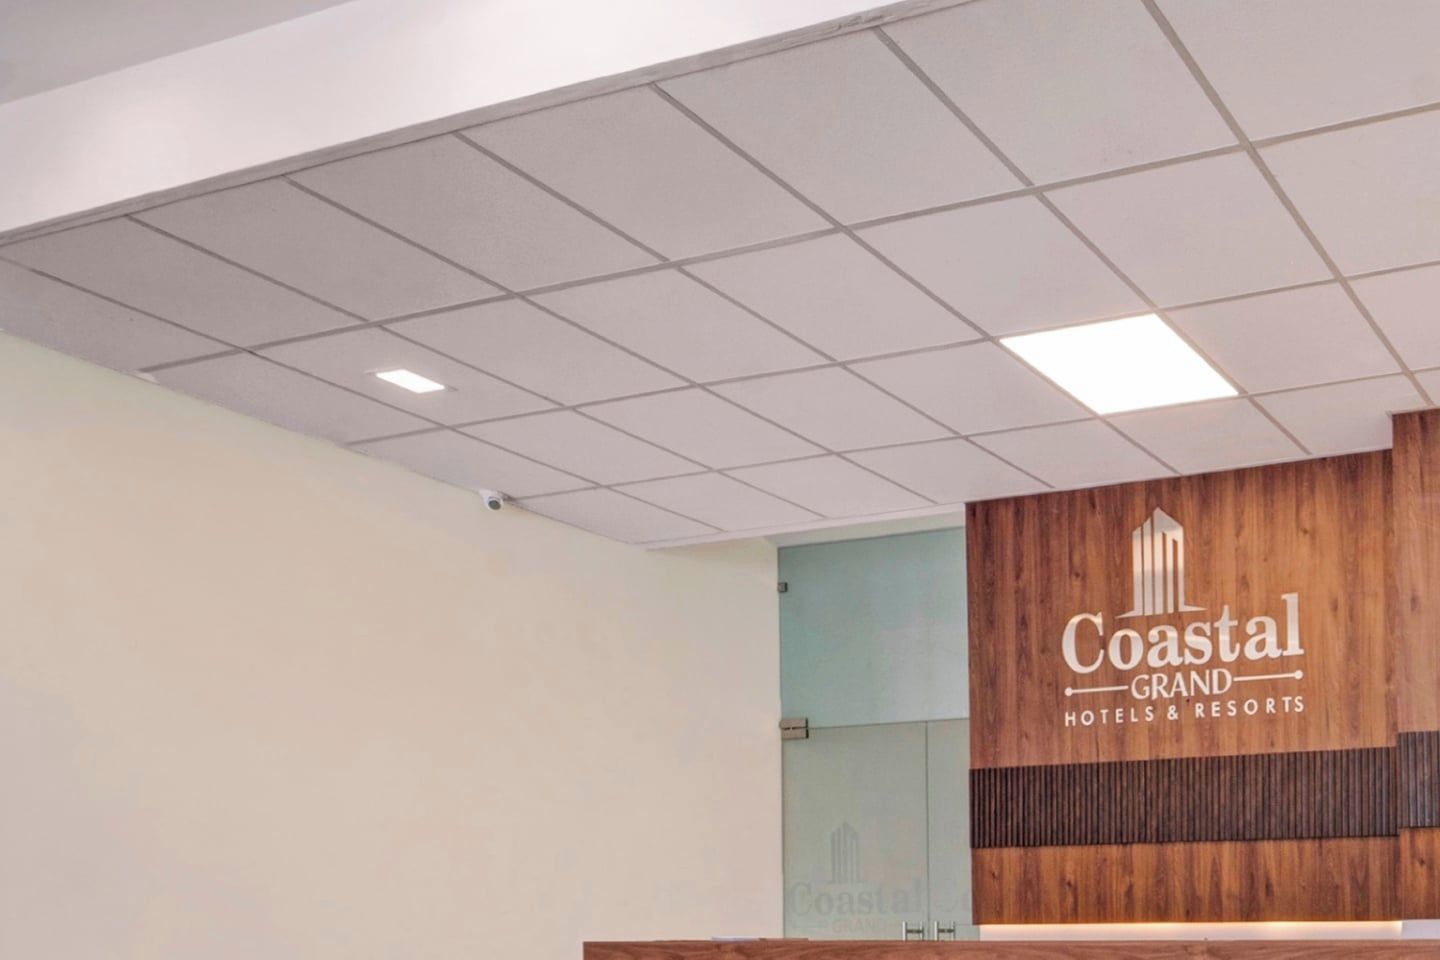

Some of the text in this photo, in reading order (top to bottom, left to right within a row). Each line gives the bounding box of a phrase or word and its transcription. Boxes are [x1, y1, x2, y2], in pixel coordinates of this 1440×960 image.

[1062, 593, 1305, 673] Coastal
[1131, 669, 1233, 700] GRAND
[1065, 696, 1304, 727] HOTELS & RESORTS
[791, 878, 922, 916] Coastal
